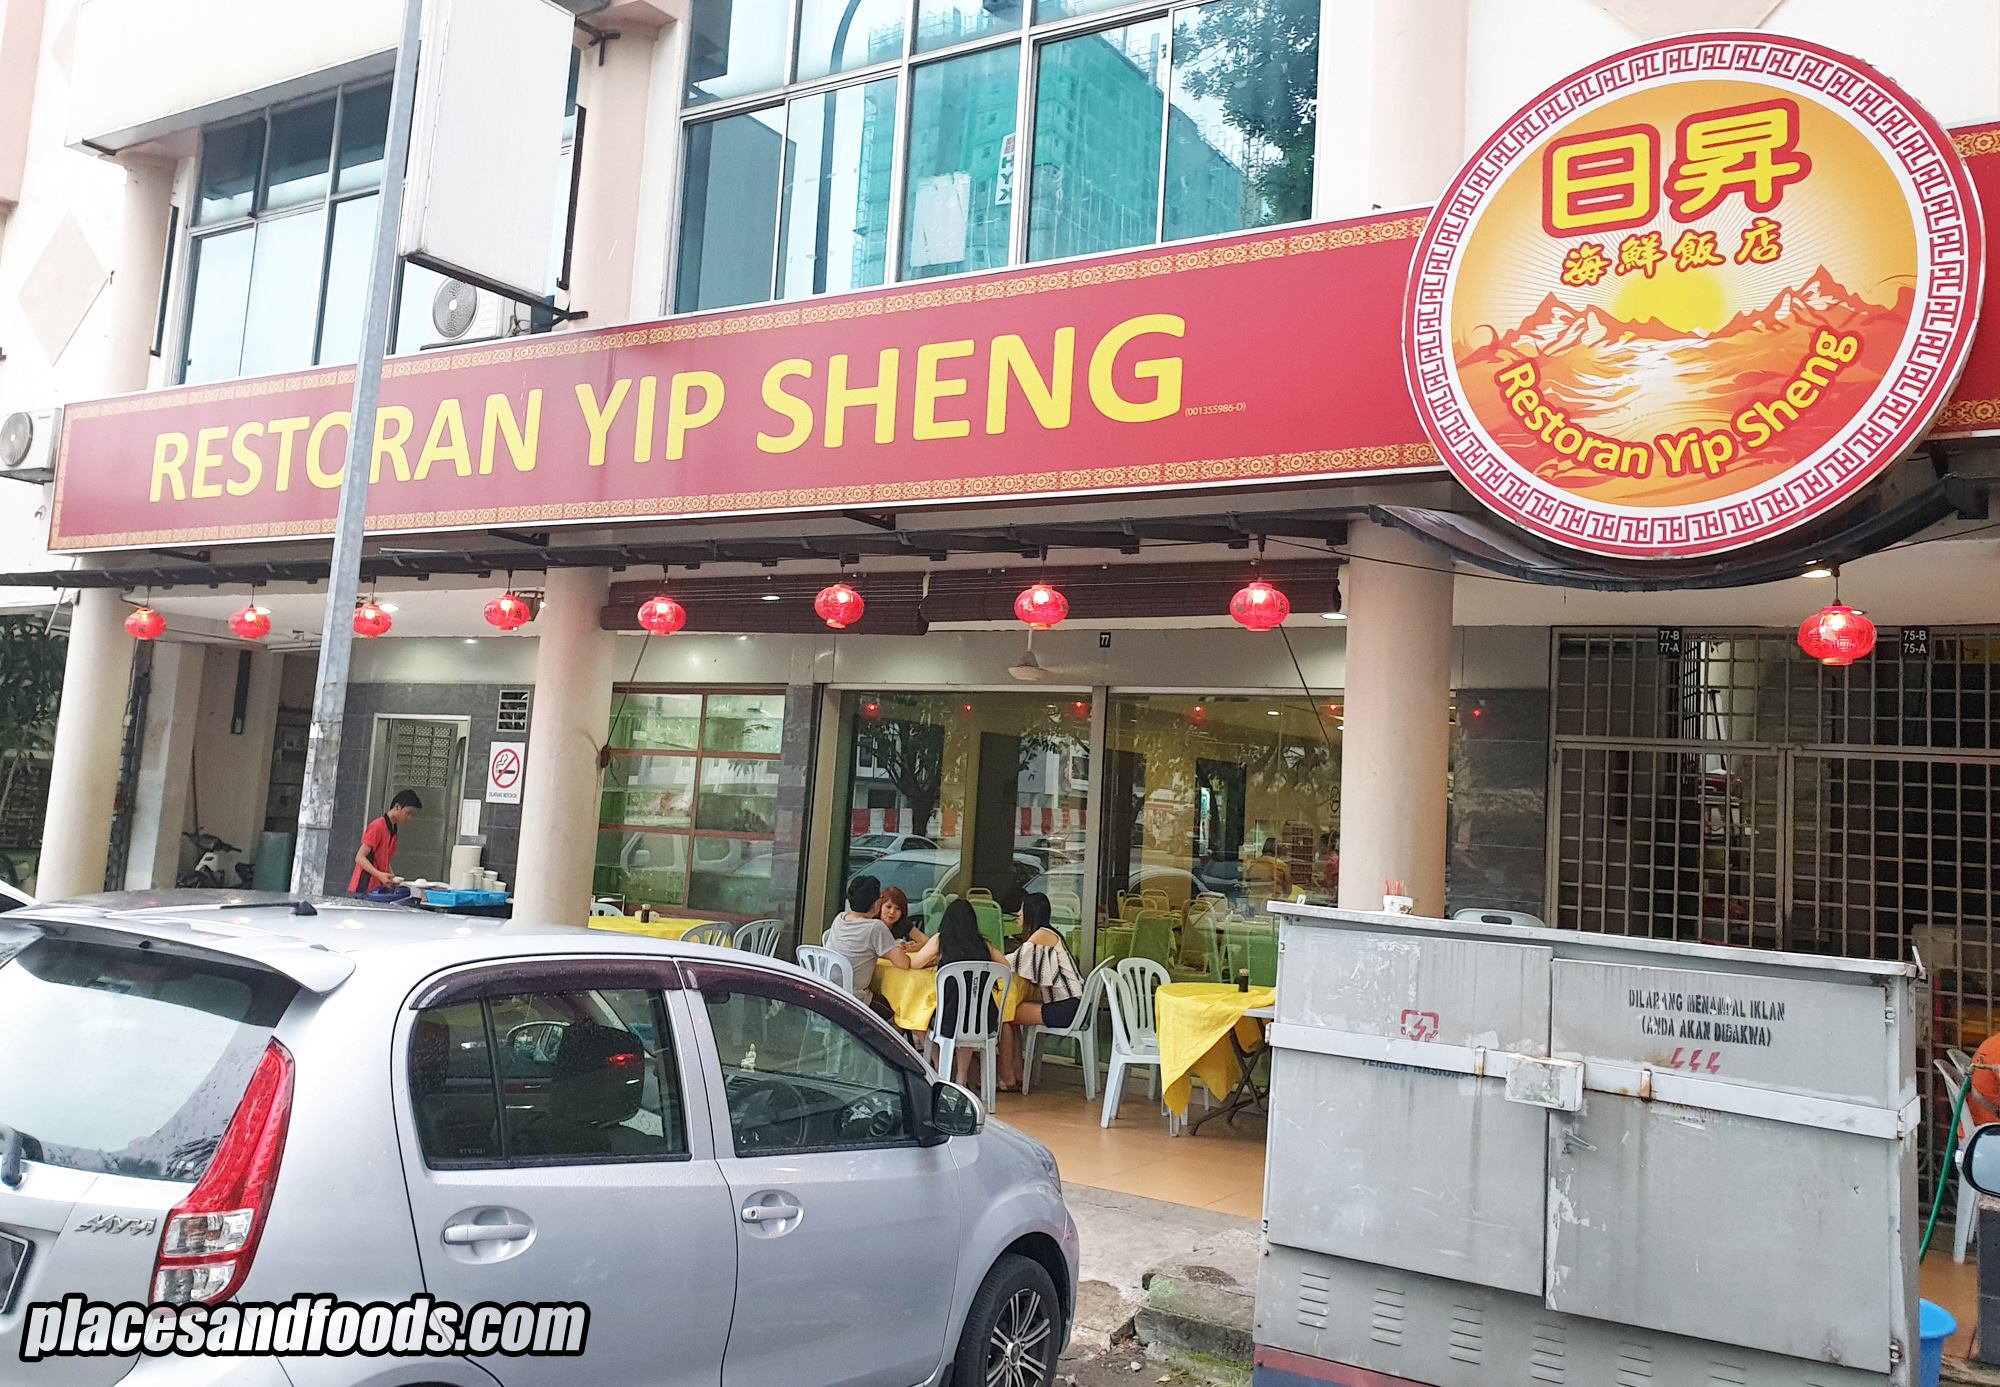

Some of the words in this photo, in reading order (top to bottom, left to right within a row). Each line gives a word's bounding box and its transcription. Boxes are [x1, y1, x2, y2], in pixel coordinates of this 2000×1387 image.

[1548, 103, 1806, 233] 日昇
[1562, 218, 1781, 286] 海鮮飯店
[149, 388, 543, 503] RESTORAN
[574, 369, 726, 467] YIP
[756, 313, 1186, 454] SHENG
[1184, 402, 1247, 417] (001355986-D)
[1498, 360, 1650, 476] Restoran
[1659, 430, 1735, 475] Yip
[1735, 330, 1859, 448] Sheng
[1100, 634, 1110, 646] 77
[1659, 630, 1680, 640] 77-B
[1903, 630, 1927, 641] 75-B
[1659, 642, 1680, 652] 77-A
[1903, 643, 1927, 654] 75-A
[1750, 1000, 1785, 1022] IKLAN
[1679, 1018, 1711, 1041] AKAN
